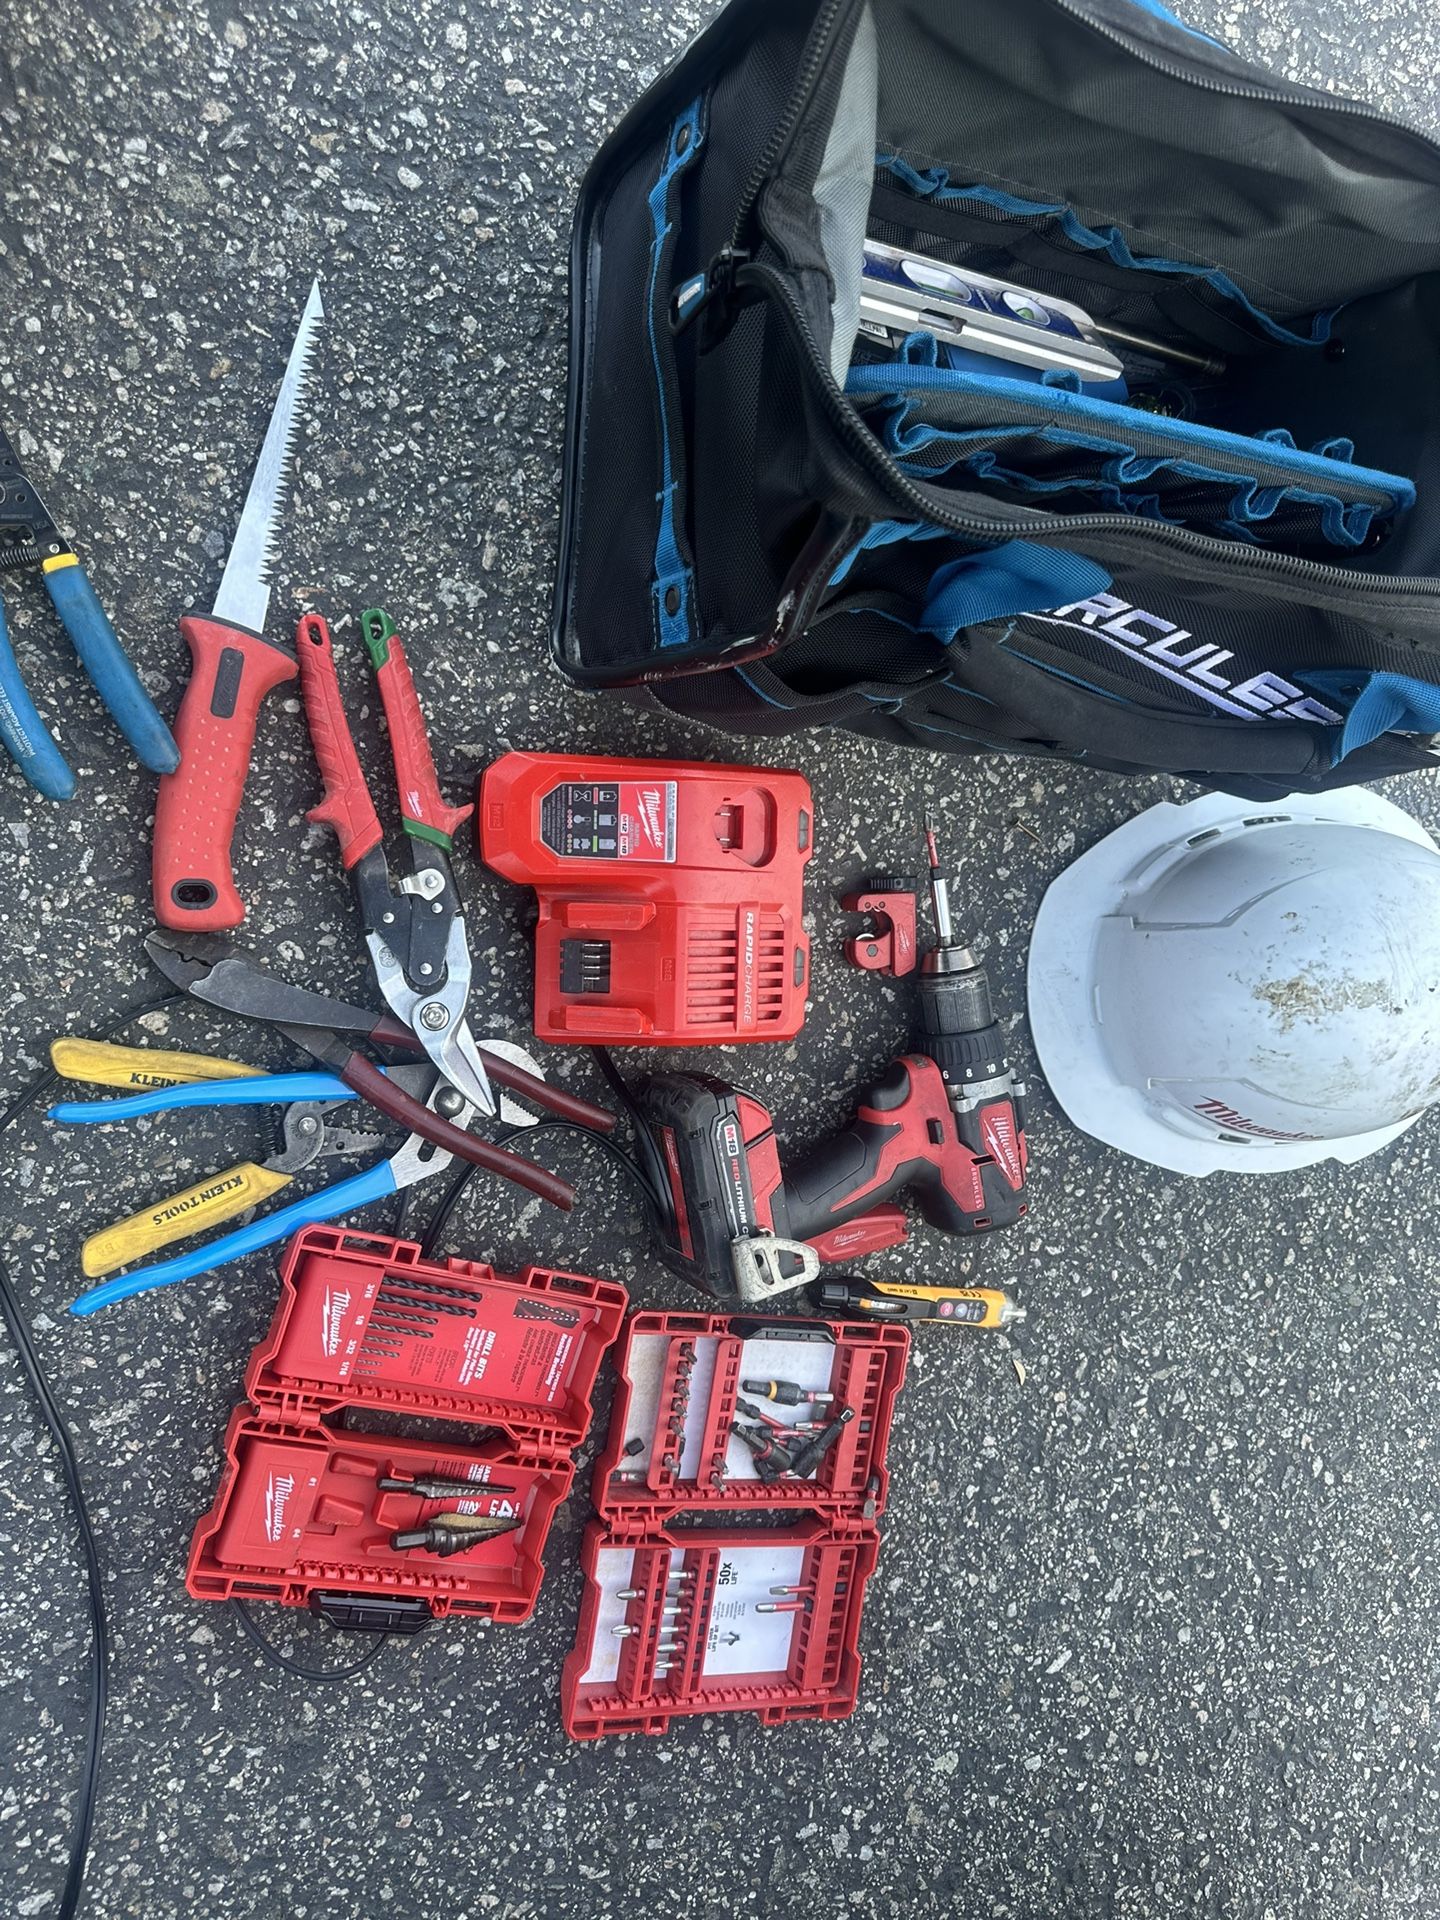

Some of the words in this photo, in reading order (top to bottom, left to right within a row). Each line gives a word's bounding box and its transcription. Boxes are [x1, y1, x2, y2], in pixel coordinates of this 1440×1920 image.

[1043, 592, 1344, 725] RCULES
[4, 698, 21, 727] AGAINST
[16, 727, 36, 756] PROTECT
[621, 815, 629, 833] M12
[642, 787, 665, 848] Milwaukee
[744, 912, 755, 1024] RAPIDCHARGE
[942, 1070, 950, 1079] 6
[966, 1068, 973, 1078] 8
[986, 1063, 997, 1074] 10
[1193, 1095, 1324, 1140] Milwaukee
[991, 1116, 1022, 1182] Milwaukee
[201, 1175, 244, 1203] KLEIN
[726, 1127, 738, 1154] M18
[732, 1158, 748, 1224] REDLITHIUM
[970, 1167, 983, 1209] BRUSHLESS
[152, 1197, 200, 1226] TOOLS
[364, 1283, 376, 1299] 3/16
[328, 1287, 352, 1356] Milwaukee
[355, 1315, 365, 1326] 1/8
[345, 1339, 357, 1355] 3/32
[481, 1330, 496, 1357] DRILL
[339, 1361, 350, 1376] 1/16
[474, 1357, 487, 1379] BITS
[545, 1356, 559, 1385] Breaking
[481, 1465, 492, 1483] JAM
[272, 1473, 296, 1542] Milwaukee
[488, 1499, 499, 1516] LIF
[719, 1562, 732, 1585] 50x
